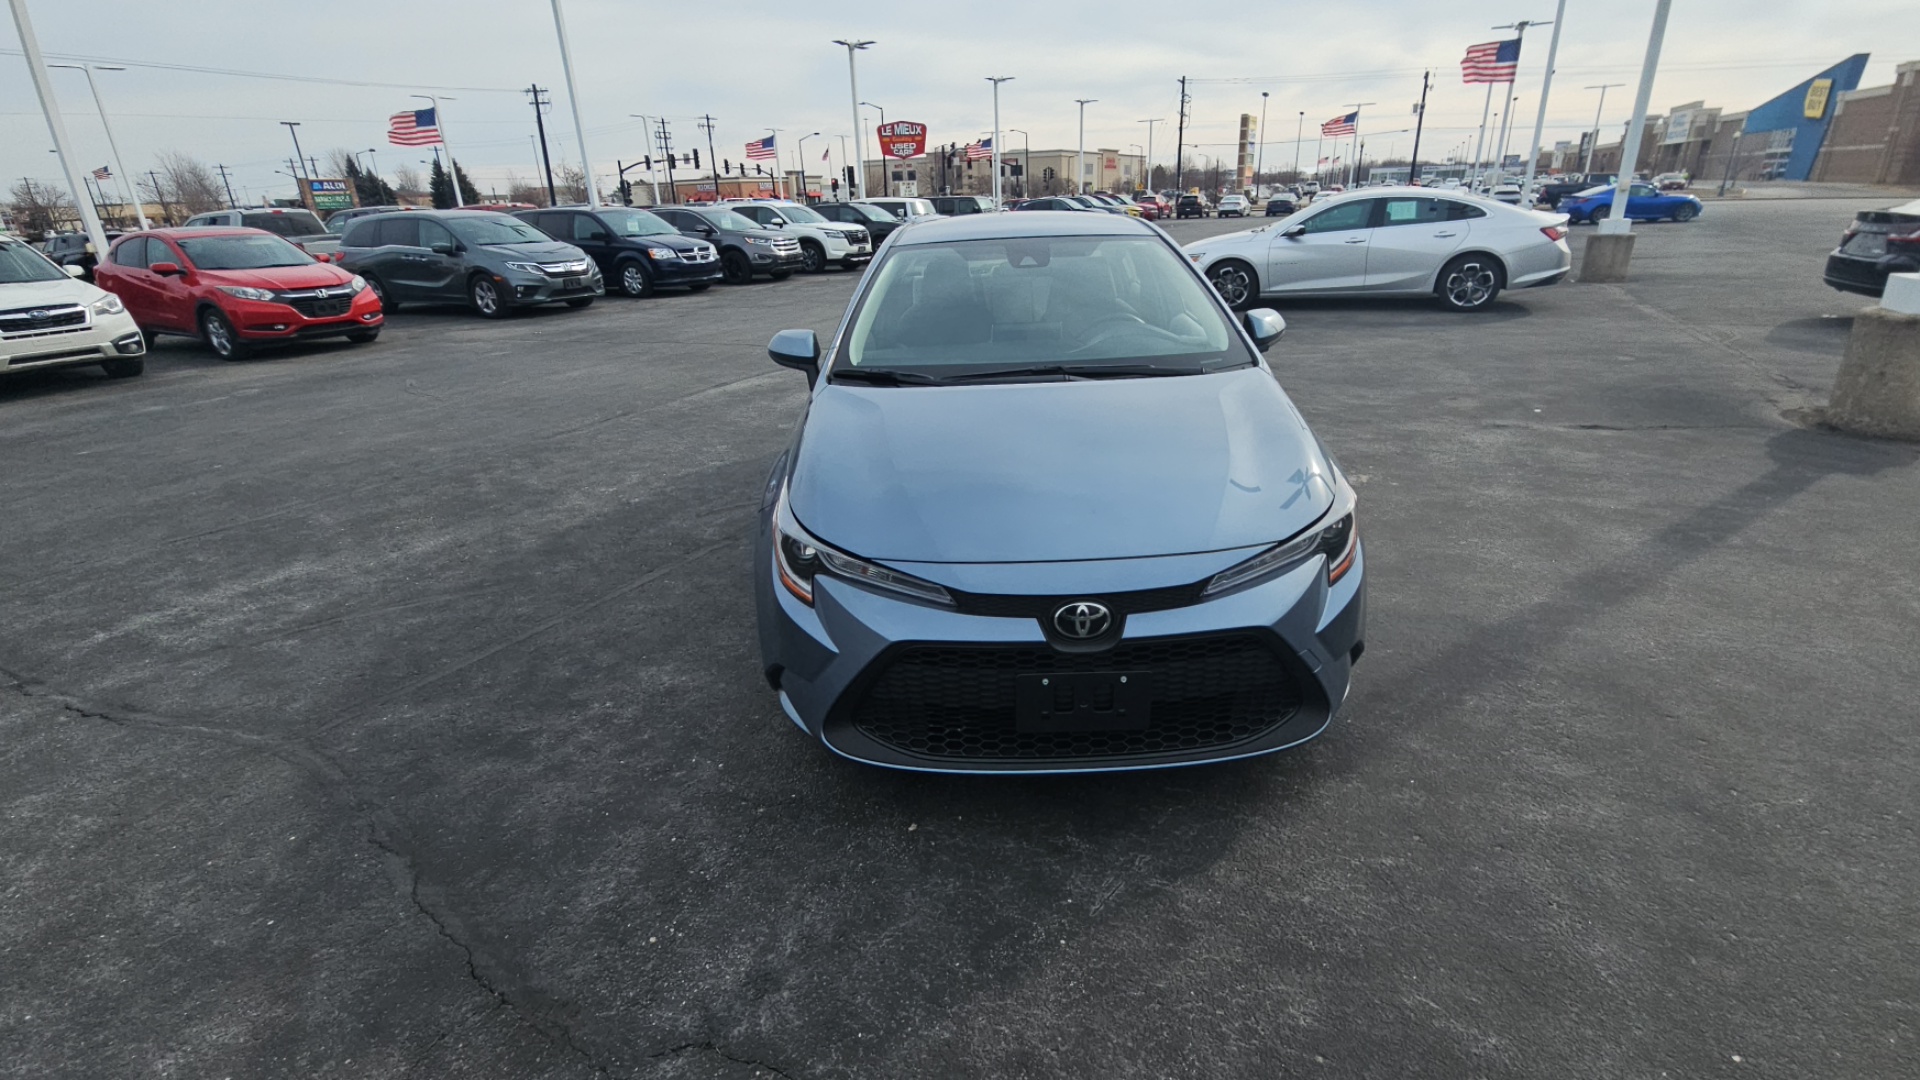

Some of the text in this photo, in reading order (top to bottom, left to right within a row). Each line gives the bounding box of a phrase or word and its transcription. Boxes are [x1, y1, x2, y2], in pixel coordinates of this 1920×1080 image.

[881, 123, 922, 135] LE MIEUX
[890, 142, 916, 150] USED
[893, 148, 914, 156] CARS
[322, 181, 346, 190] ALDI
